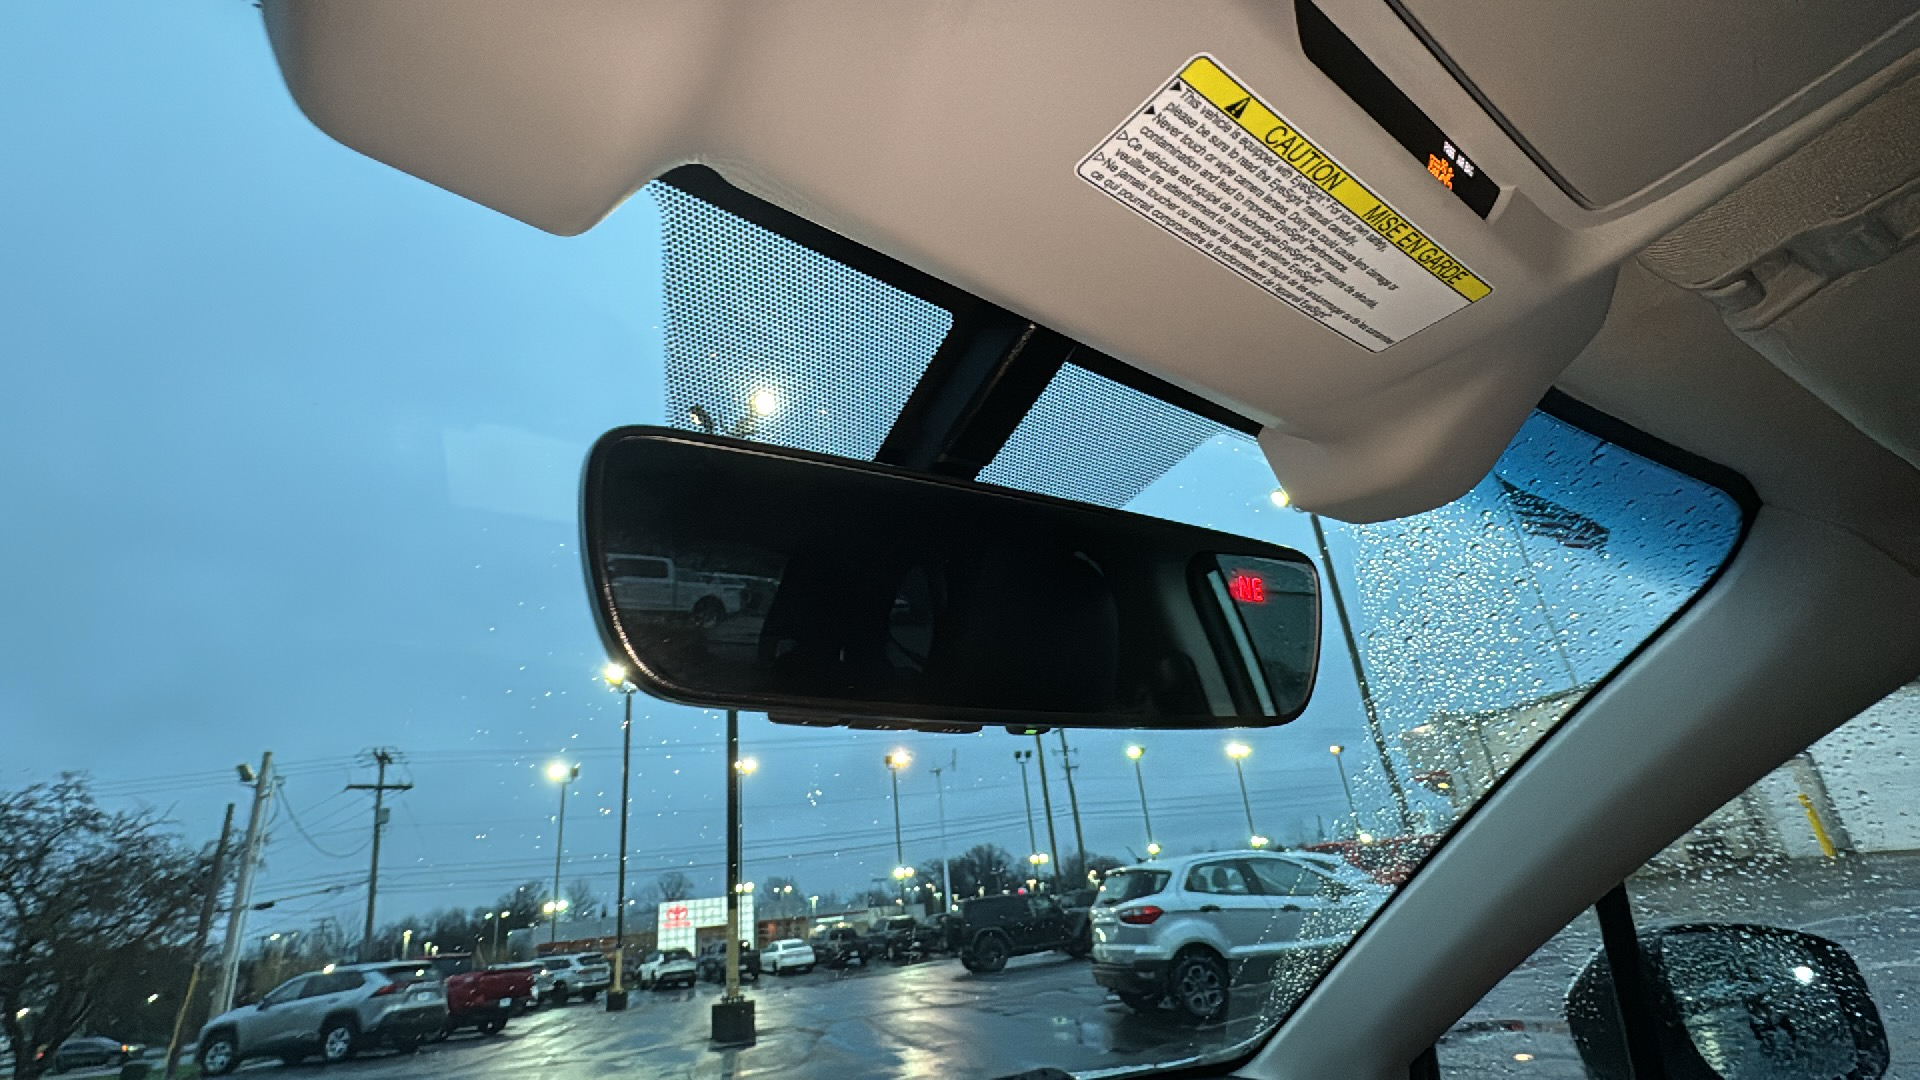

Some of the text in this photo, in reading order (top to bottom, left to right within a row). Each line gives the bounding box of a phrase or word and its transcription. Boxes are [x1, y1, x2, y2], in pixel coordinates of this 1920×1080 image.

[1090, 171, 1104, 181] ce
[1104, 179, 1122, 191] qui
[1116, 188, 1154, 212] pourrait
[1151, 209, 1206, 244] compromettre
[1204, 240, 1214, 250] le
[1211, 246, 1267, 281] fonctionnement
[1102, 158, 1118, 172] Ne
[1114, 168, 1148, 191] jamais
[1146, 188, 1180, 210] toucher
[1176, 209, 1190, 218] ou
[1188, 216, 1221, 237] essuyer
[1217, 234, 1232, 245] les
[1257, 260, 1270, 268] au
[1267, 266, 1290, 281] risque
[1296, 284, 1308, 293] les
[1115, 148, 1151, 176] veuillez
[1148, 171, 1164, 185] lire
[1162, 182, 1220, 220] attentivement
[1215, 216, 1226, 225] le
[1224, 222, 1256, 242] manuel
[1251, 240, 1264, 249] du
[1260, 247, 1291, 266] système
[1127, 137, 1142, 151] Ce
[1142, 149, 1179, 176] véhicule
[1177, 174, 1195, 187] est
[1191, 183, 1222, 205] équipé
[1219, 202, 1232, 212] de
[1230, 208, 1240, 218] la
[1238, 214, 1281, 244] technologie
[1309, 262, 1325, 273] Par
[1321, 271, 1347, 288] mesure
[1344, 286, 1355, 294] de
[1140, 126, 1202, 172] contamination
[1199, 169, 1220, 183] and
[1215, 178, 1239, 196] lead
[1233, 192, 1244, 202] to
[1242, 198, 1278, 222] improper
[1152, 112, 1184, 137] Never
[1180, 134, 1206, 156] touch
[1204, 153, 1217, 162] or
[1214, 160, 1236, 177] wipe
[1234, 174, 1265, 198] camera
[1262, 193, 1289, 216] lenses.
[1287, 212, 1312, 232] Doing
[1308, 227, 1320, 236] so
[1317, 234, 1340, 249] could
[1334, 247, 1356, 262] cause
[1352, 258, 1369, 271] lens
[1366, 268, 1392, 286] damage
[1162, 102, 1198, 128] please
[1195, 123, 1210, 138] be
[1208, 135, 1230, 152] sure
[1227, 147, 1239, 159] to
[1236, 156, 1260, 173] read
[1255, 169, 1272, 182] the
[1302, 205, 1333, 226] manual
[1180, 88, 1202, 109] This
[1200, 106, 1232, 133] vehicle
[1229, 128, 1241, 140] is
[1238, 137, 1280, 167] equipped
[1275, 164, 1293, 179] with
[1326, 202, 1342, 215] For
[1335, 212, 1357, 226] your
[1352, 224, 1370, 236] own
[1265, 126, 1469, 285] CAUTION MISE EN GARDE
